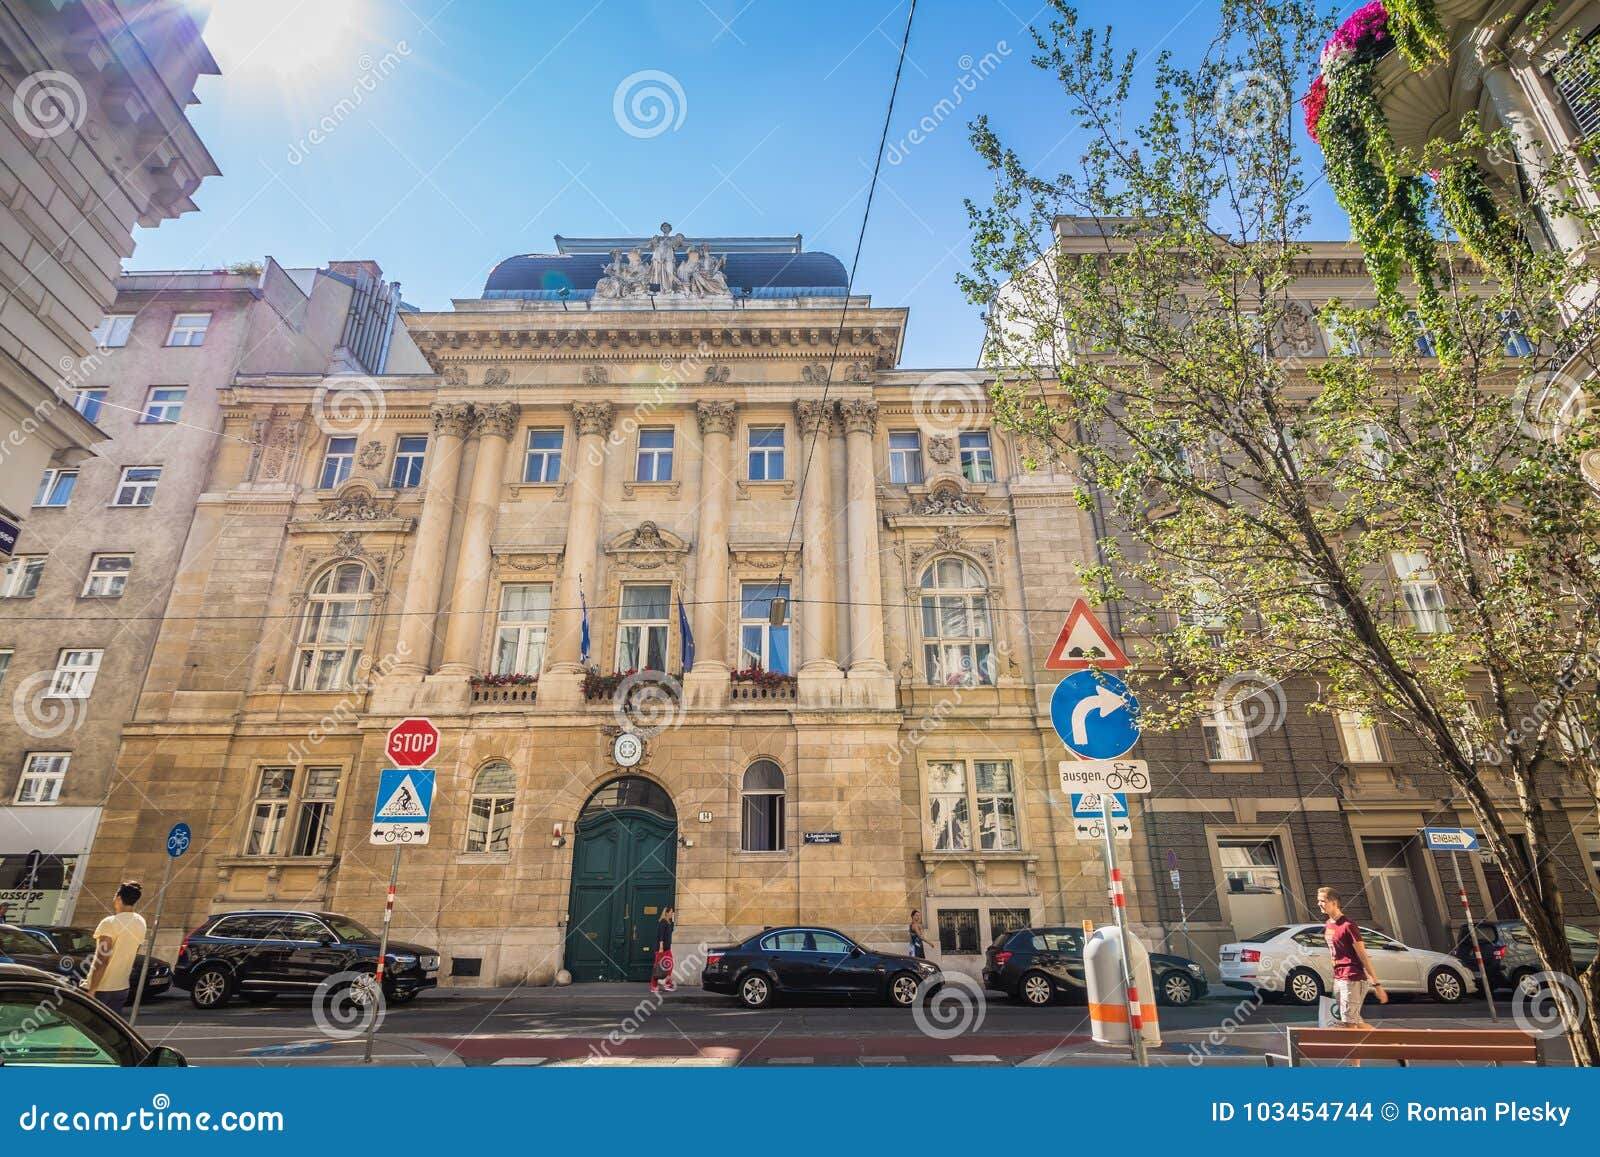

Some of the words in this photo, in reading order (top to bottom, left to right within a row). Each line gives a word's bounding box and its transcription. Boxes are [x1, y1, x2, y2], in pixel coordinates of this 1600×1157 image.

[392, 733, 434, 752] STOP
[1062, 771, 1104, 784] ausgen.
[1431, 833, 1462, 843] EINBAHN
[0, 891, 44, 903] assage
